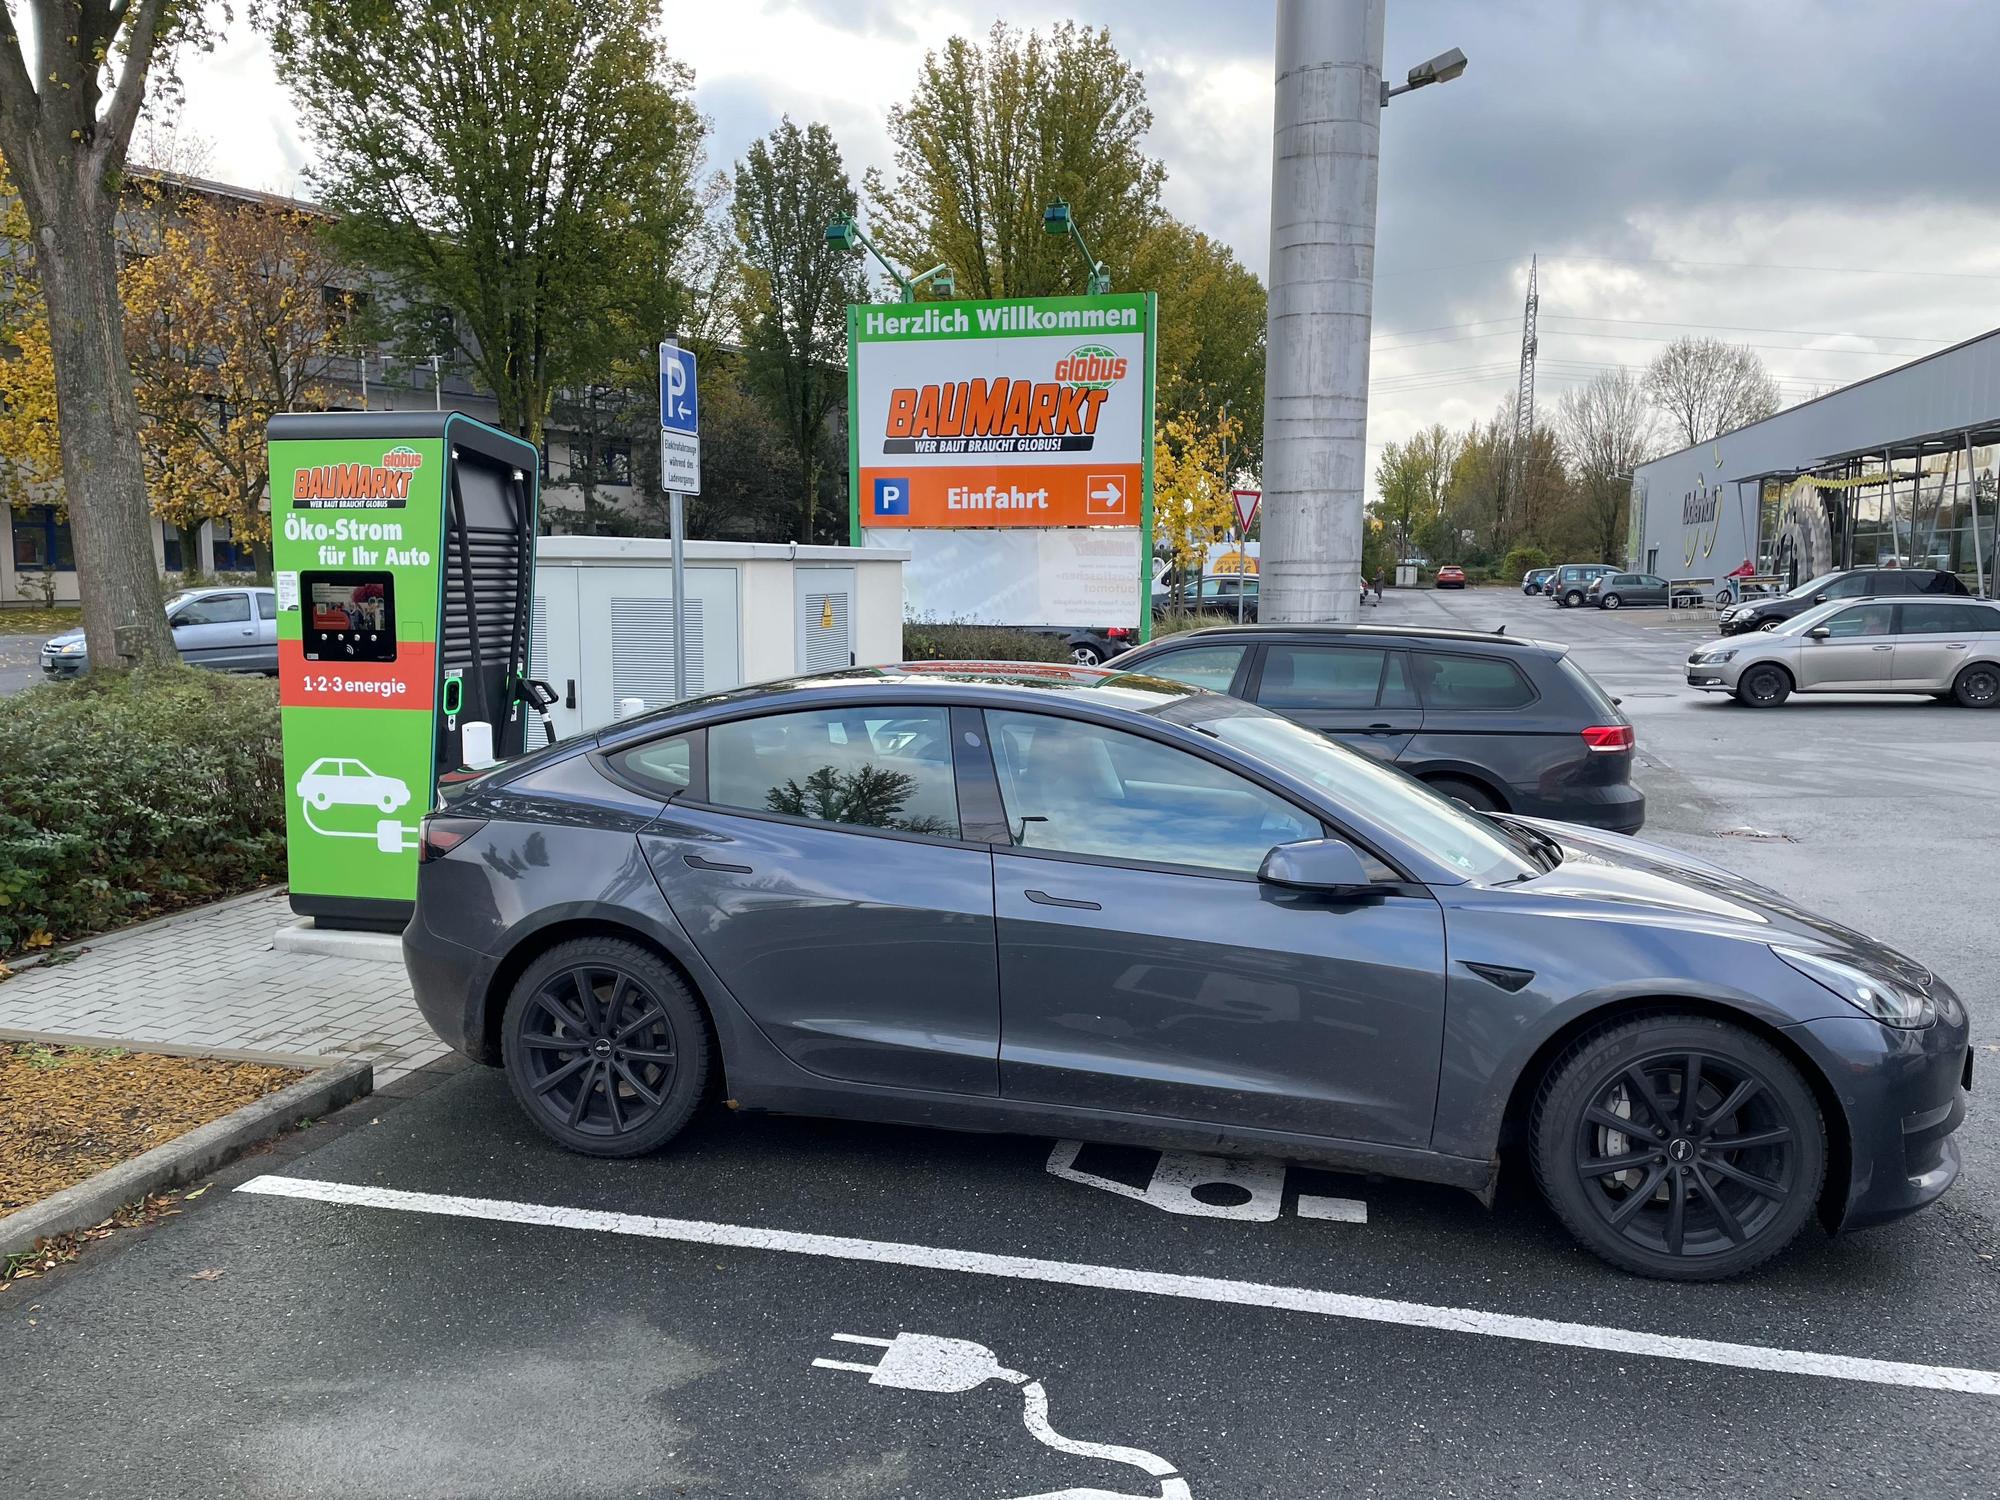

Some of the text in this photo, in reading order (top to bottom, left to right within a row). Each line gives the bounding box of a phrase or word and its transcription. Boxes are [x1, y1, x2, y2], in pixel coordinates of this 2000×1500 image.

[866, 305, 1137, 335] Herzlich Willkommen
[1055, 353, 1128, 383] Globus
[667, 357, 687, 418] P
[886, 377, 1109, 437] BAUMARKT
[914, 438, 1062, 453] WER BAUT BRAUCHT GLOBUS!
[294, 463, 413, 500] BAUMARKT
[310, 500, 388, 508] WER BAUT BRAUCHT GLOBUS
[883, 486, 900, 509] P
[947, 485, 1049, 509] Einfahrt
[284, 512, 402, 541] Öko-Strom
[318, 545, 430, 566] für Ihr Auto
